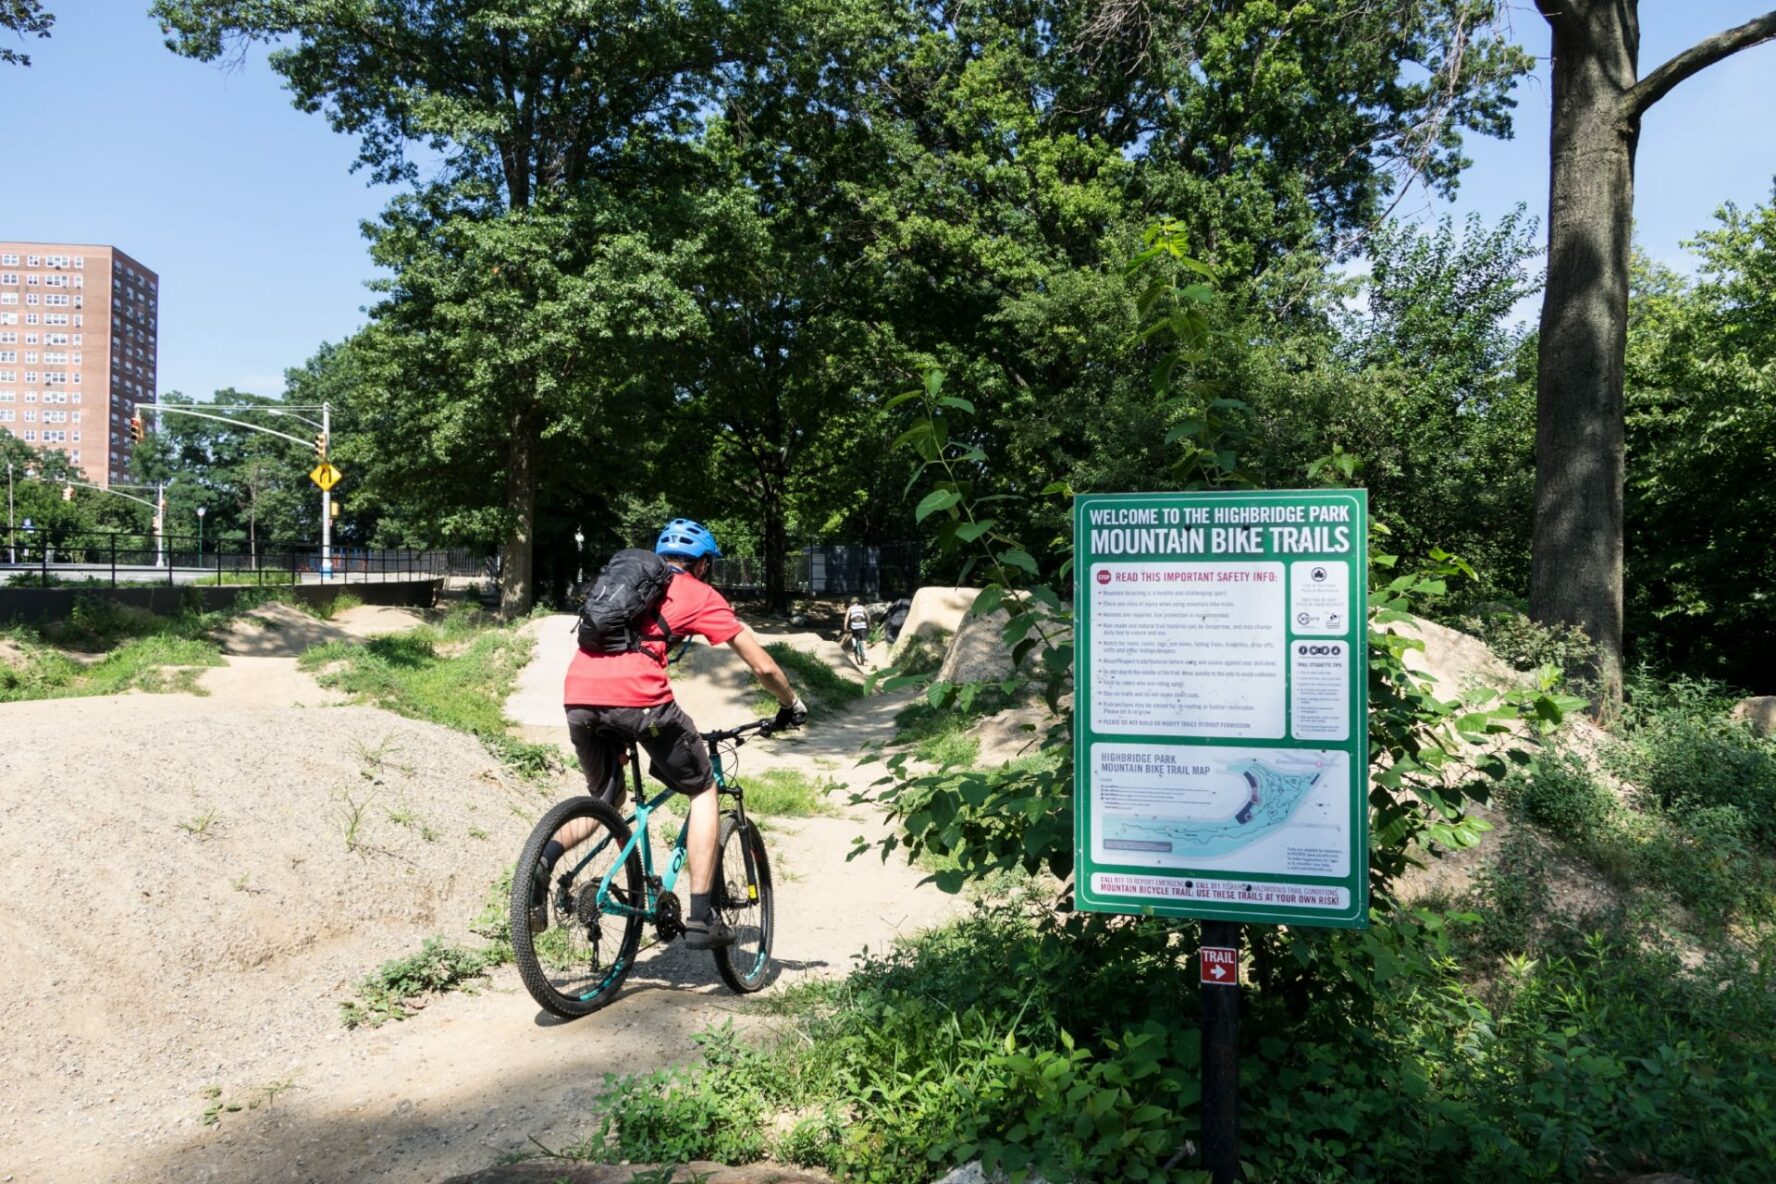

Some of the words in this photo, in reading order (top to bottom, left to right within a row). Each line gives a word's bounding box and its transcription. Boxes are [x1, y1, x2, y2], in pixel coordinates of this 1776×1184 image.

[1090, 508, 1159, 526] WELCOME
[1162, 508, 1180, 524] TO
[1184, 507, 1210, 524] THE
[1214, 506, 1305, 524] HIGHBRIDGE
[1309, 505, 1350, 522] PARK
[1090, 528, 1204, 554] MOUNTAIN
[1211, 527, 1264, 554] BIKE
[1269, 526, 1350, 553] TRAILS
[1115, 572, 1138, 582] READ
[1142, 572, 1161, 582] THIS
[1164, 572, 1214, 582] IMPORTANT
[1217, 572, 1250, 582] SAFETY
[1253, 572, 1278, 582] INFO:
[1101, 752, 1152, 764] HIGHBRIDGE
[1154, 754, 1176, 764] PARK
[1101, 763, 1144, 774] MOUNTAIN
[1146, 764, 1164, 775] BIKE
[1166, 766, 1190, 776] TRAIL
[1192, 766, 1210, 776] MAP
[1101, 883, 1137, 893] MOUNTAIN
[1140, 886, 1169, 896] BICYCLE
[1196, 890, 1210, 898] USE
[1213, 890, 1236, 899] THESE
[1238, 892, 1264, 901] TRAILS
[1265, 894, 1274, 902] AT
[1276, 894, 1296, 903] YOUR
[1298, 895, 1316, 904] OWN
[1318, 896, 1340, 906] RISK!
[1202, 950, 1235, 964] TRAIL
